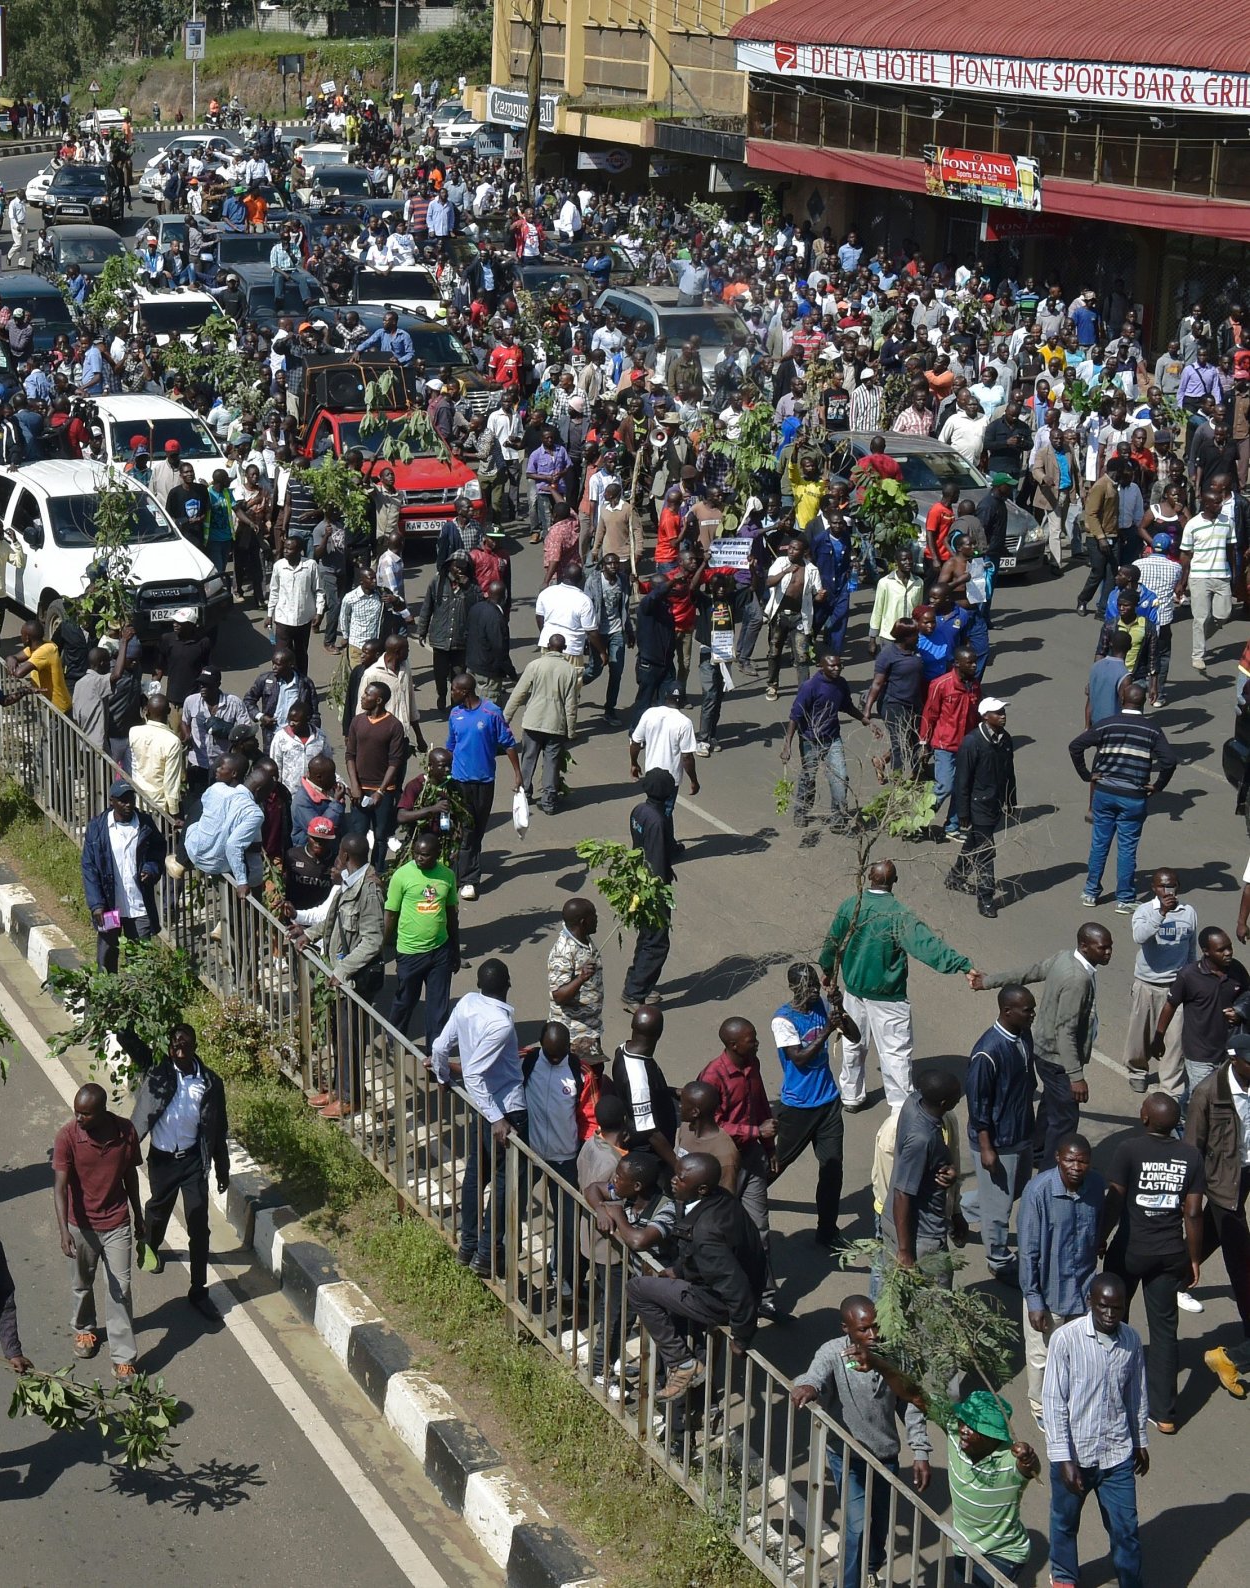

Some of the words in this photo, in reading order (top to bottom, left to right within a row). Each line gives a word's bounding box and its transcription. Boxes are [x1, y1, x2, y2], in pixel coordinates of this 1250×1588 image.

[811, 48, 867, 79] DELTA
[876, 52, 940, 84] HOTEL
[956, 59, 1048, 91] FONTAINE
[1052, 65, 1129, 97] SPORTS
[1134, 71, 1176, 102] BAR
[1180, 75, 1197, 104] &
[494, 93, 528, 122] kampus
[539, 102, 553, 122] all
[943, 159, 1012, 176] FONTAINE
[956, 169, 972, 179] Sports
[406, 521, 422, 530] KAW
[151, 610, 169, 620] KBZ
[295, 874, 331, 887] KENYA
[1142, 1161, 1188, 1174] WORLD'S
[1140, 1171, 1185, 1184] LONGEST
[1138, 1180, 1184, 1192] LASTING
